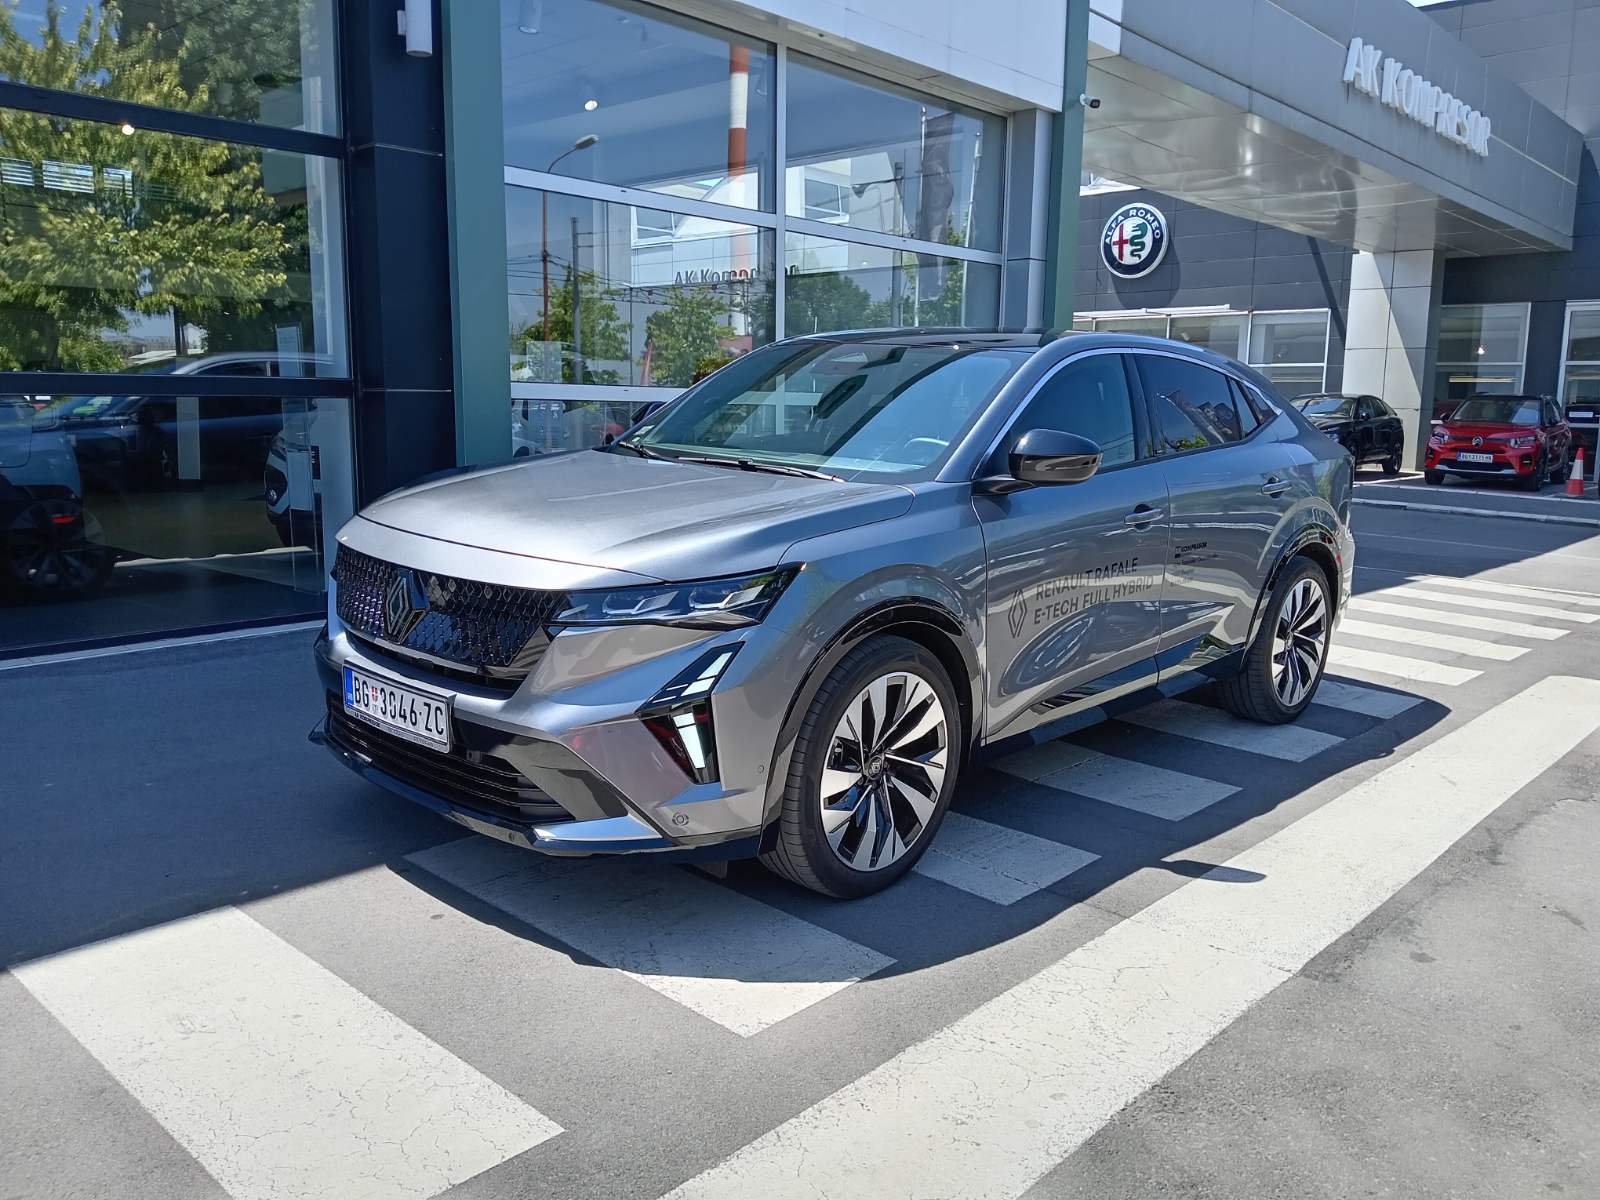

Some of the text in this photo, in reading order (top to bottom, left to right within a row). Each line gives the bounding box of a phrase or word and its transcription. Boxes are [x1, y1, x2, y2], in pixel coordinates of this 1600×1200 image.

[1343, 37, 1491, 158] AK KOMPRESOR
[1105, 209, 1161, 245] ALFA ROMEO
[674, 269, 696, 285] AK
[1036, 557, 1138, 600] RENAULT RAFALE
[1034, 596, 1079, 625] E-TECH
[1083, 588, 1110, 608] FULL
[1113, 576, 1154, 600] HYBRID
[354, 676, 369, 707] BG
